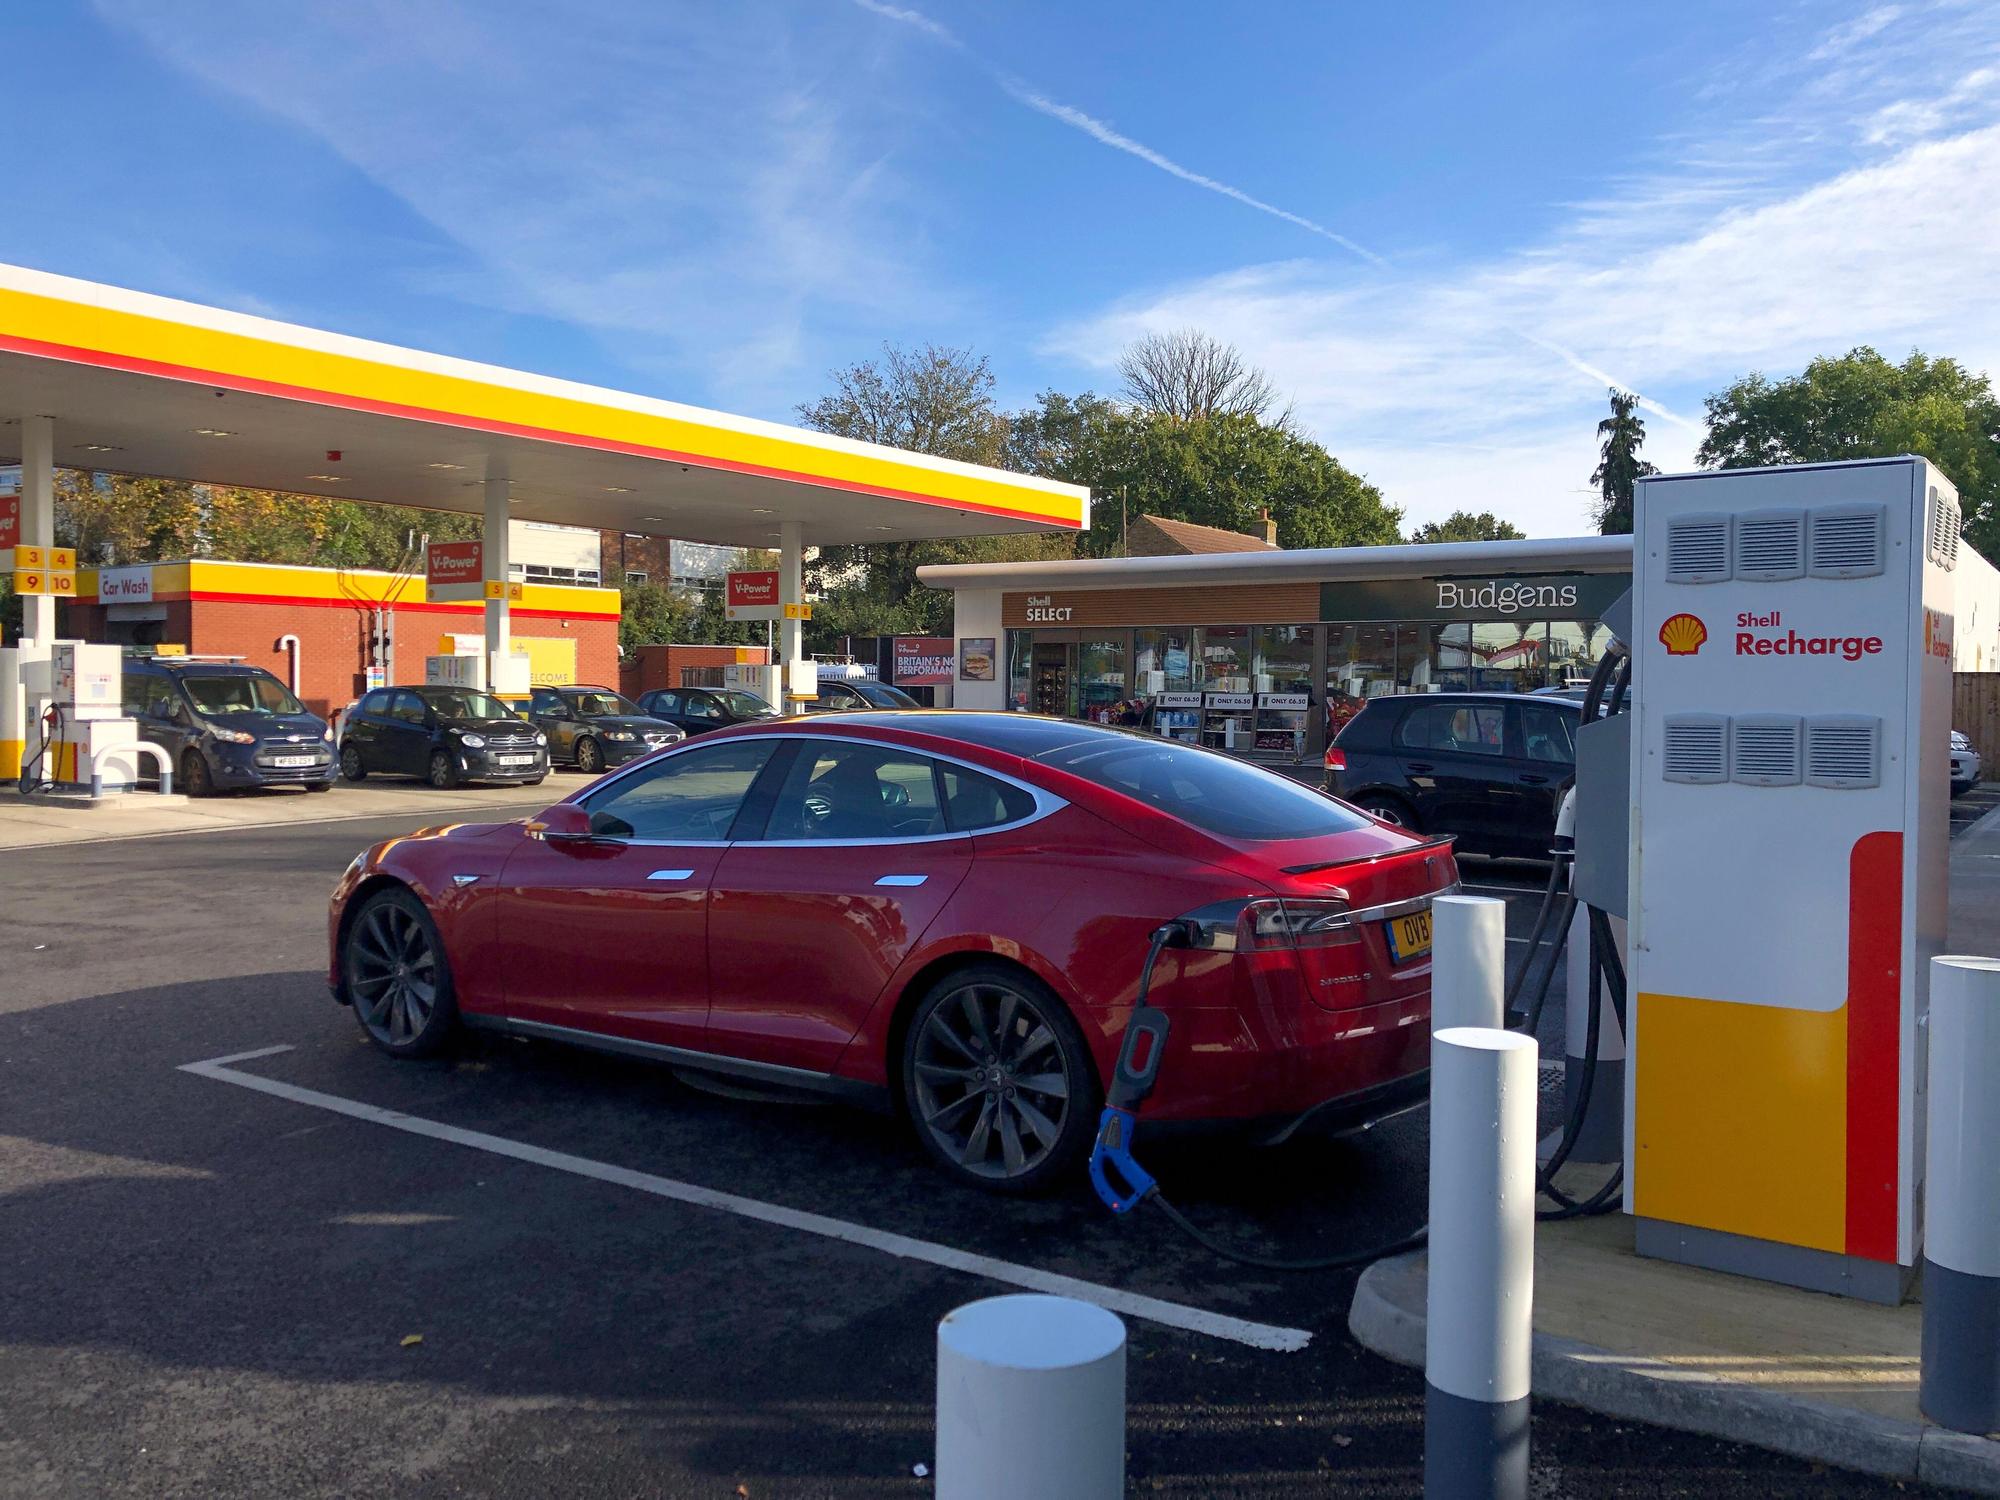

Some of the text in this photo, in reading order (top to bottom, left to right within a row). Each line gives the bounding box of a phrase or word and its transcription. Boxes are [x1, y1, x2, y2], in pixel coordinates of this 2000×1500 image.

[29, 551, 66, 565] 3 4
[432, 555, 477, 569] V-Power
[27, 576, 70, 590] 9 10
[102, 577, 149, 595] Car Wash
[735, 584, 771, 593] V-Power
[493, 585, 518, 595] 5 6
[1027, 595, 1051, 606] Shell
[1435, 581, 1577, 614] Budgens
[1026, 608, 1072, 621] SELECT
[1736, 612, 1780, 627] Shell
[1735, 629, 1883, 661] Recharge
[897, 656, 941, 666] BRITAIN'S
[897, 665, 955, 675] PERFORMAN
[530, 672, 569, 683] ELCOME
